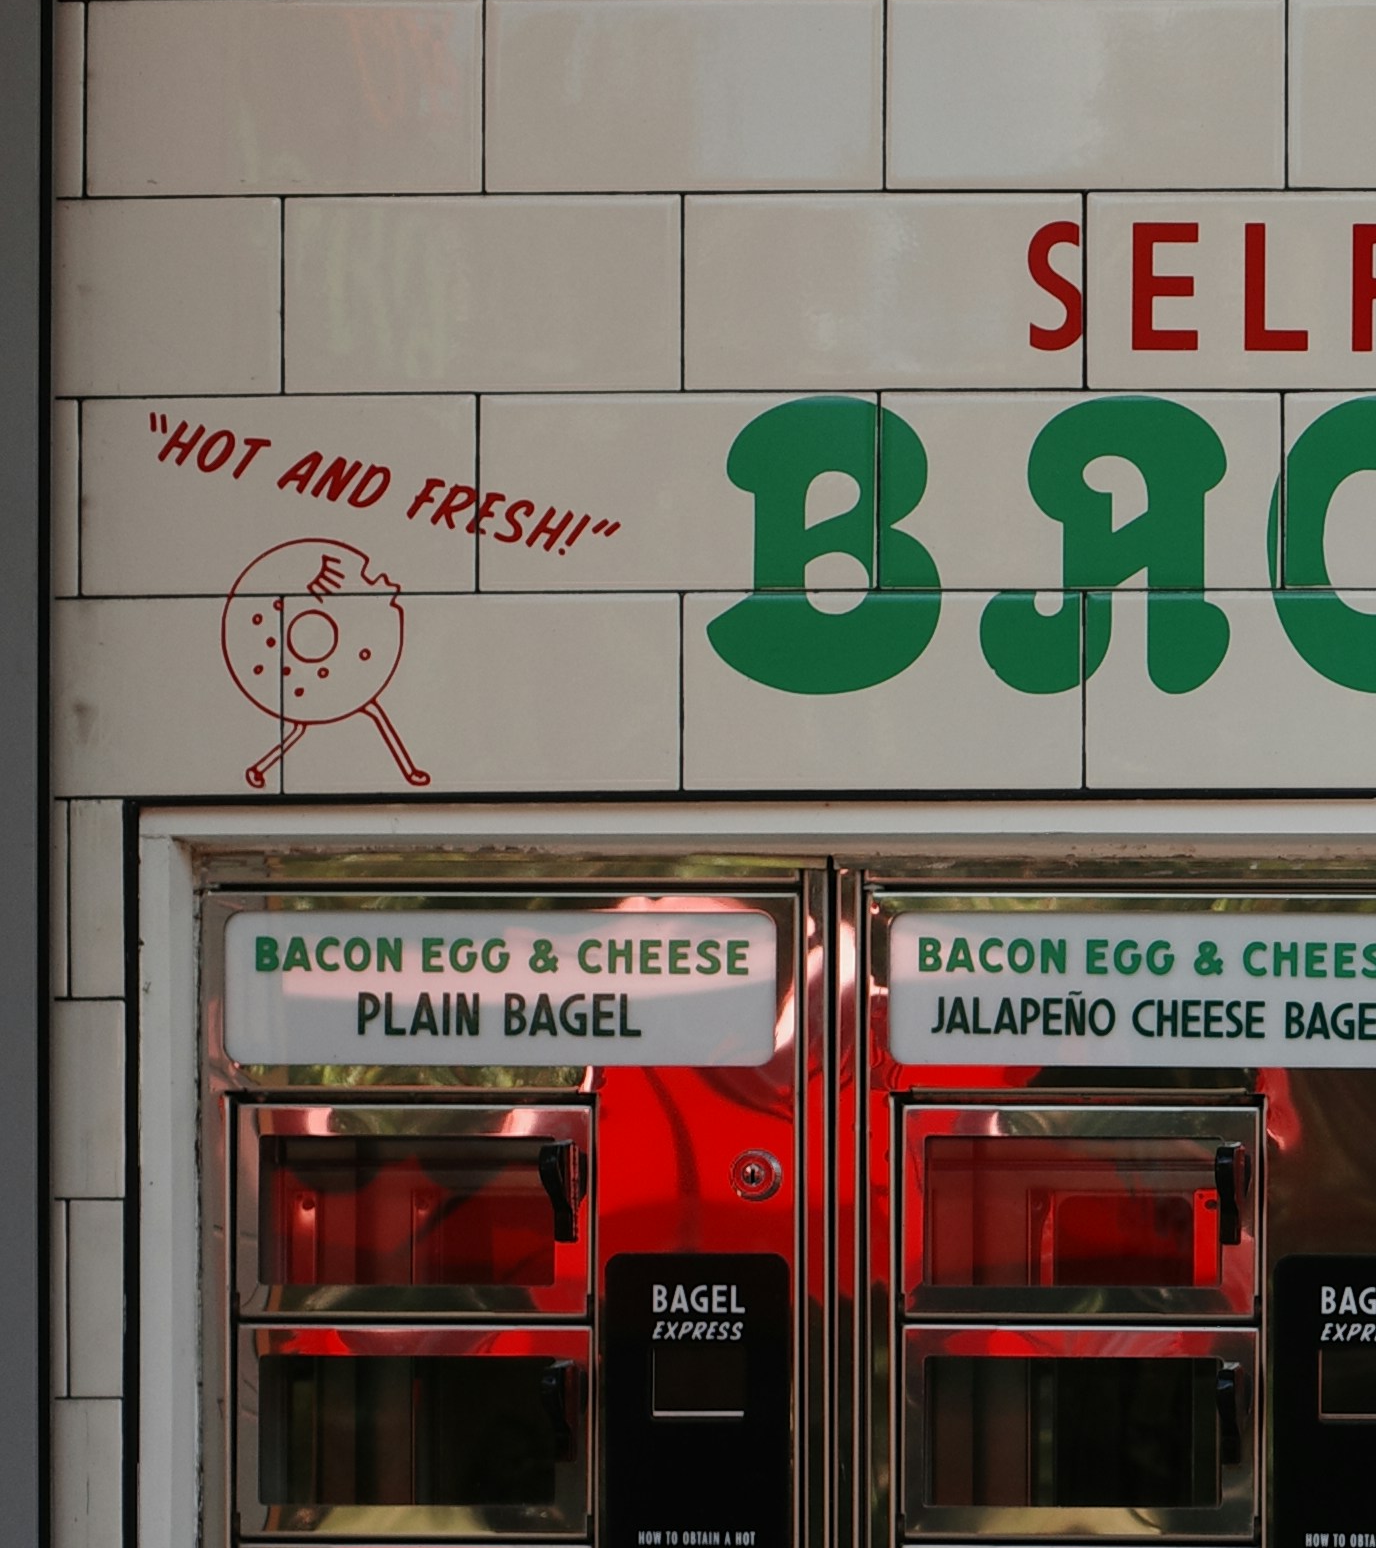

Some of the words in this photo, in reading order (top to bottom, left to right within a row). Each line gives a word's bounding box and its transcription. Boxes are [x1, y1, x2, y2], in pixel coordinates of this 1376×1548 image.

[277, 451, 391, 508] AND
[255, 936, 402, 973] BACON
[422, 937, 509, 973] EGG
[529, 940, 558, 973] &
[578, 940, 749, 974] CHEESE
[919, 938, 1066, 974] BACON
[1086, 939, 1175, 976] EGG
[1194, 941, 1223, 976] &
[358, 993, 479, 1036] PLAIN
[504, 994, 641, 1037] BAGEL
[932, 991, 1115, 1036] JALAPEÑO
[1132, 1000, 1265, 1038] CHEESE
[652, 1284, 746, 1314] BAGEL
[652, 1320, 744, 1341] EXPRESS
[638, 1531, 662, 1545] HOW
[665, 1530, 678, 1545] TO
[682, 1531, 720, 1545] OBTAIN
[724, 1531, 731, 1545] A
[735, 1531, 756, 1546] HOT
[1305, 1533, 1330, 1548] HOW
[1332, 1533, 1346, 1548] TO
